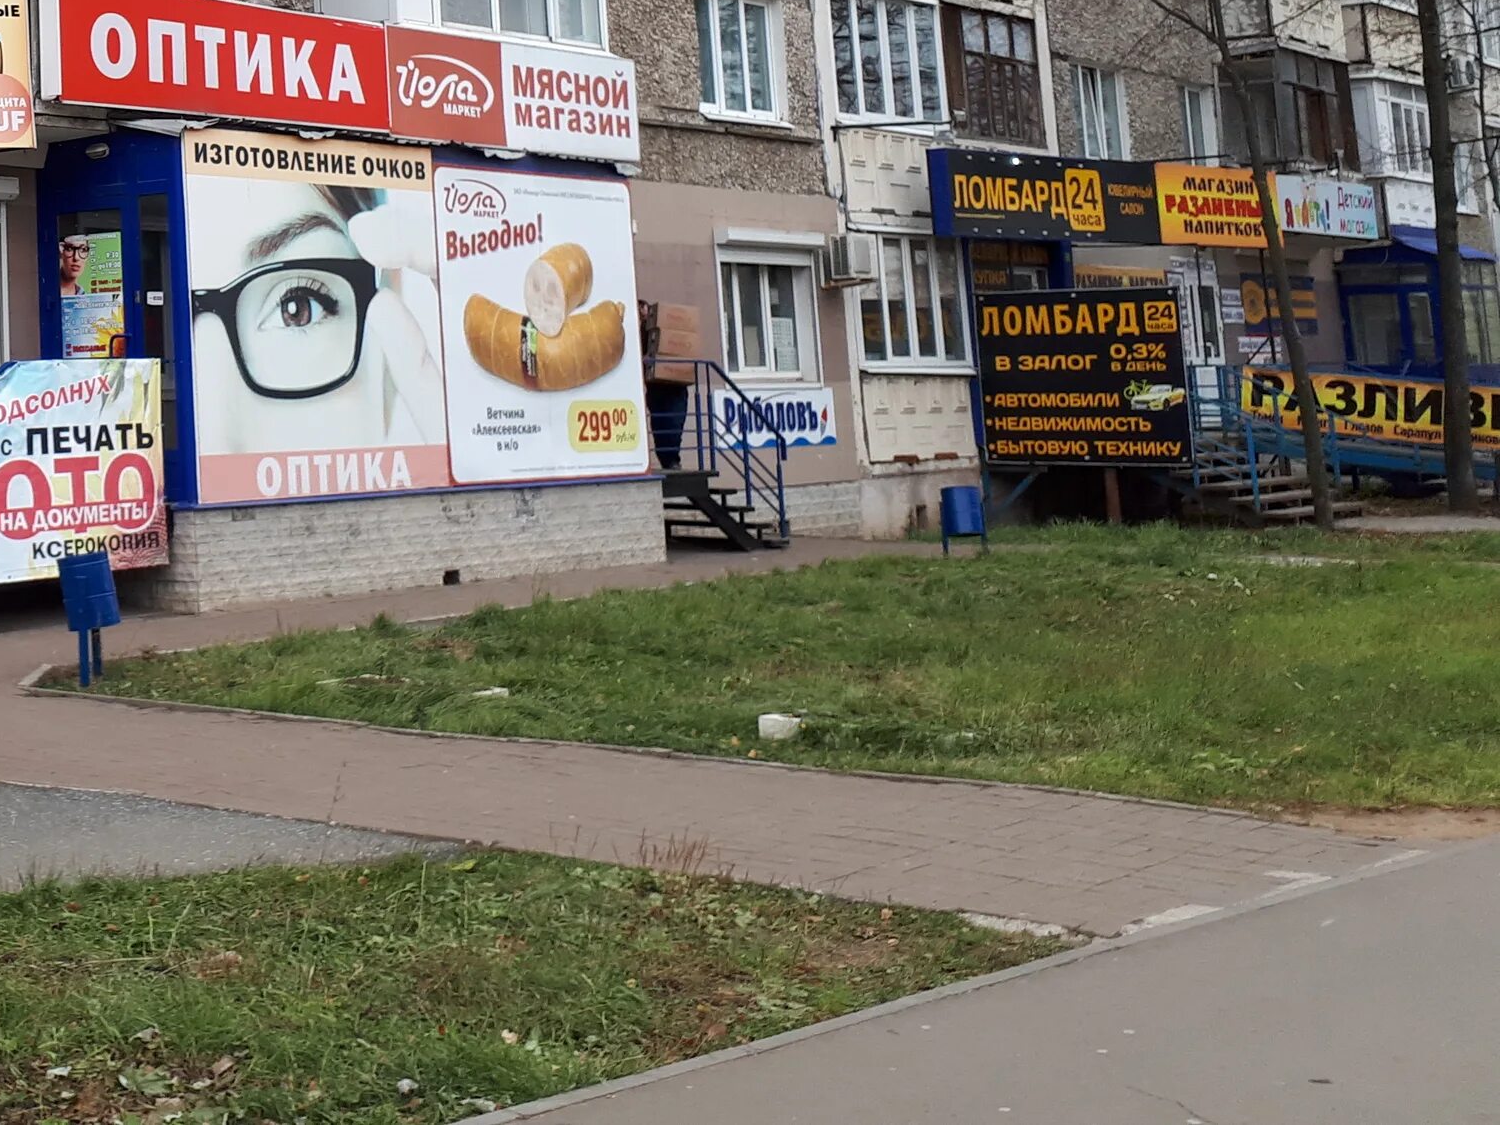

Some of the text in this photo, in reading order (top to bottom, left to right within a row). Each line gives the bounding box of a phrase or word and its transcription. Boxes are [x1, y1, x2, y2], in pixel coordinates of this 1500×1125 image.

[90, 13, 365, 105] ОПТИКА
[512, 64, 629, 110] МЯСНОЙ
[444, 102, 482, 118] МАРКЕТ
[514, 102, 631, 138] магазин
[194, 143, 425, 180] ИЗГОТОВЛЕНИЕ ОЧКОВ
[954, 174, 1098, 220] ЛОМБАРД 24
[1165, 194, 1263, 218] РАЗЛИВНЫ
[1337, 186, 1374, 211] Детский
[474, 210, 499, 218] МАРКЕТ
[1072, 213, 1101, 226] часа
[1120, 203, 1144, 216] САЛОН
[446, 213, 543, 261] Выгодно!
[981, 302, 1139, 336] ЛОМБАРД
[1147, 304, 1175, 321] 24
[1149, 323, 1174, 331] часа
[995, 343, 1166, 371] В ЗАЛОГ 0,3%
[1111, 361, 1166, 372] В ДЕНЬ
[994, 393, 1119, 408] АВТОМОБИЛИ
[487, 407, 524, 419] Ветчина
[995, 417, 1151, 432] НЕДВИЖИМОСТЬ
[26, 423, 153, 455] ПЕЧАТЬ
[472, 424, 541, 435] «Алексеевская»
[1393, 426, 1442, 441] Сарапул
[998, 441, 1181, 457] БЫТОВУЮ ТЕХНИКУ
[256, 449, 411, 496] ОПТИКА
[0, 502, 148, 532] НА ДОКУМЕНТЫ
[32, 532, 160, 559] КСЕРОКОПИЯ
